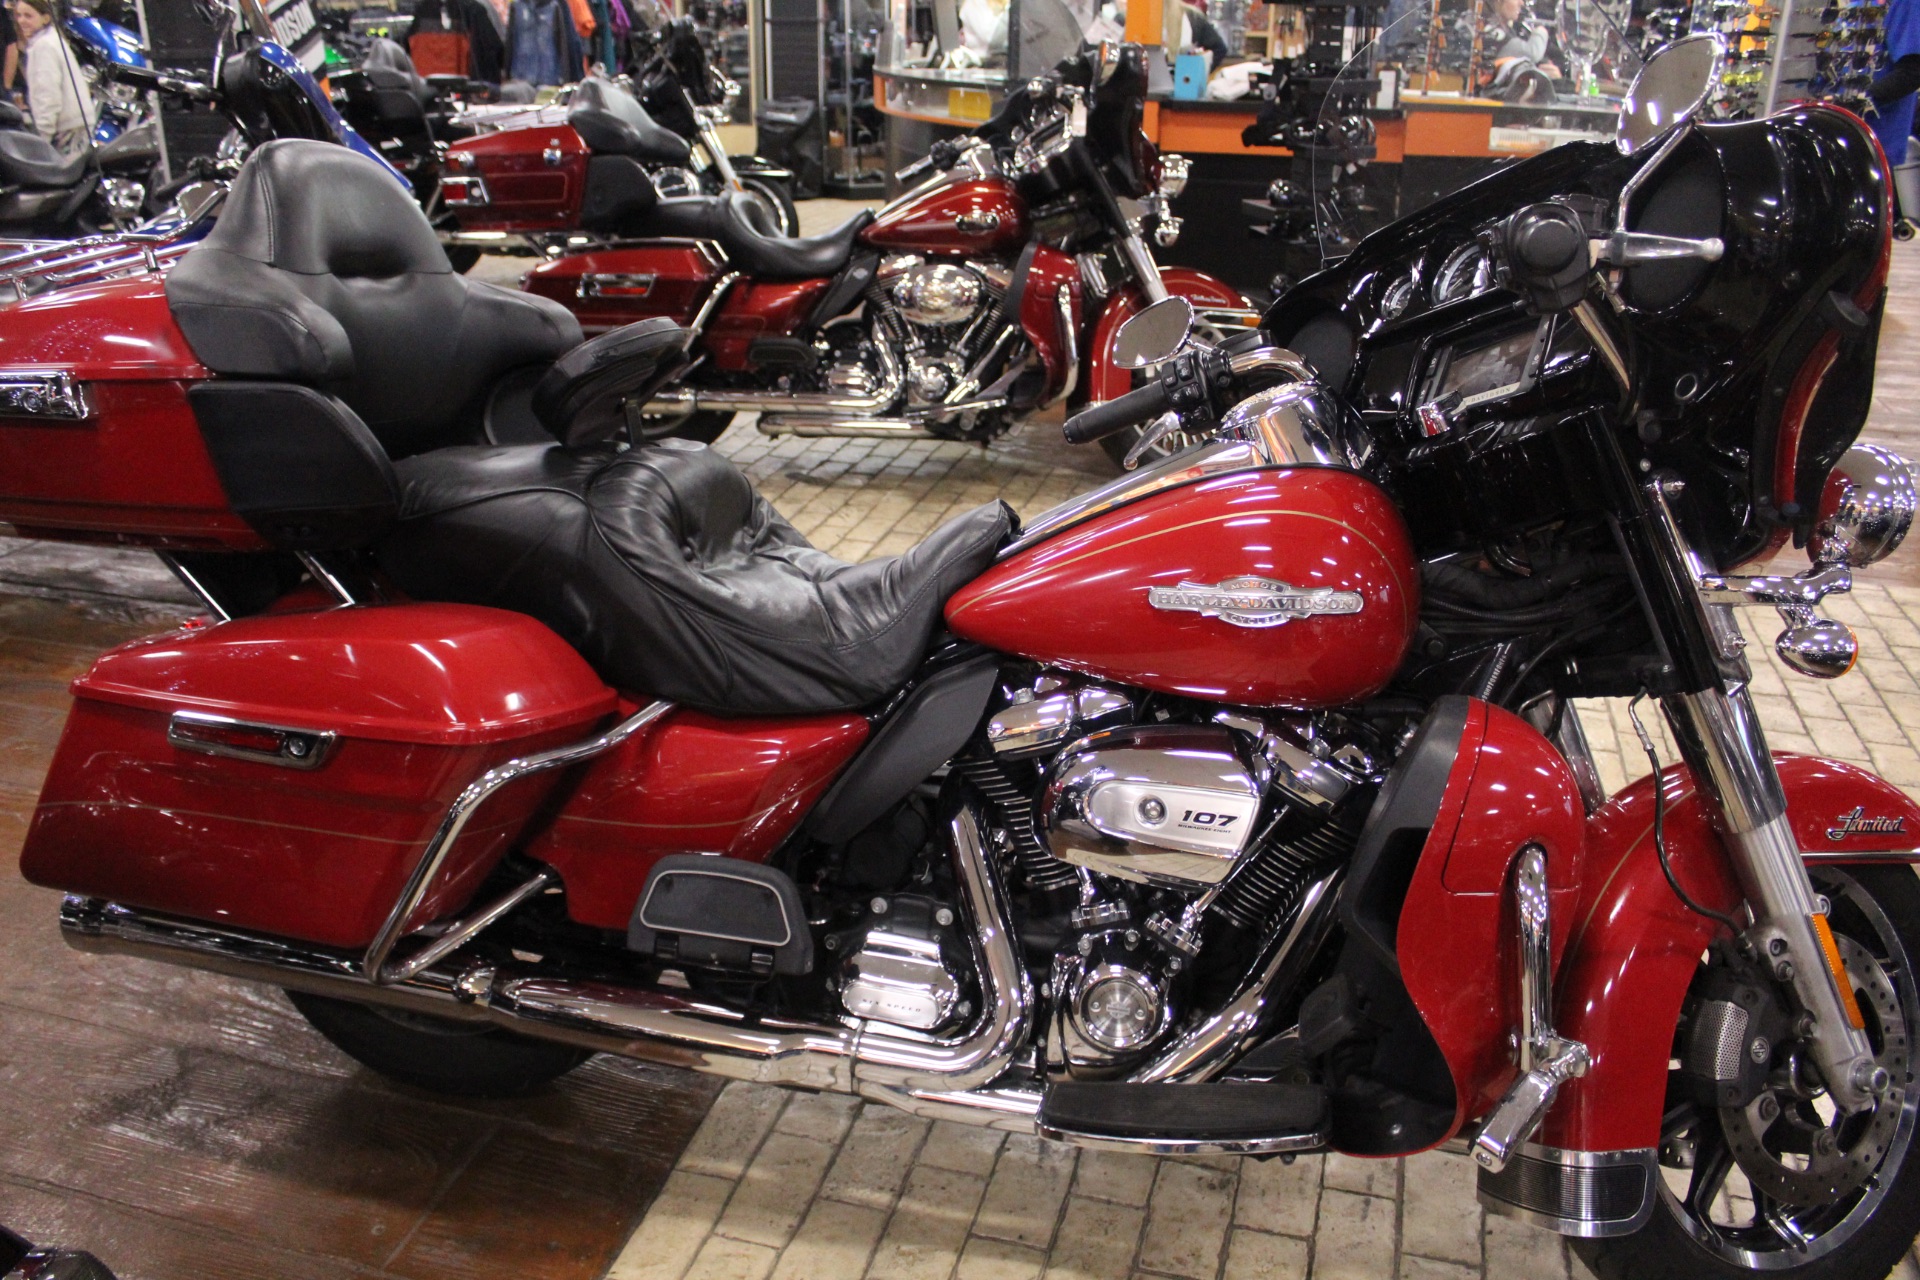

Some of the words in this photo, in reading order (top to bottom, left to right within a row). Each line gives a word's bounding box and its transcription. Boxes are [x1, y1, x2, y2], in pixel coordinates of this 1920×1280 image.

[1231, 581, 1278, 590] MOTOR
[1156, 592, 1355, 610] HARLEY-DAVIDSON
[1230, 613, 1279, 624] CYCLES
[1181, 809, 1239, 827] 107
[1825, 805, 1907, 841] Limited
